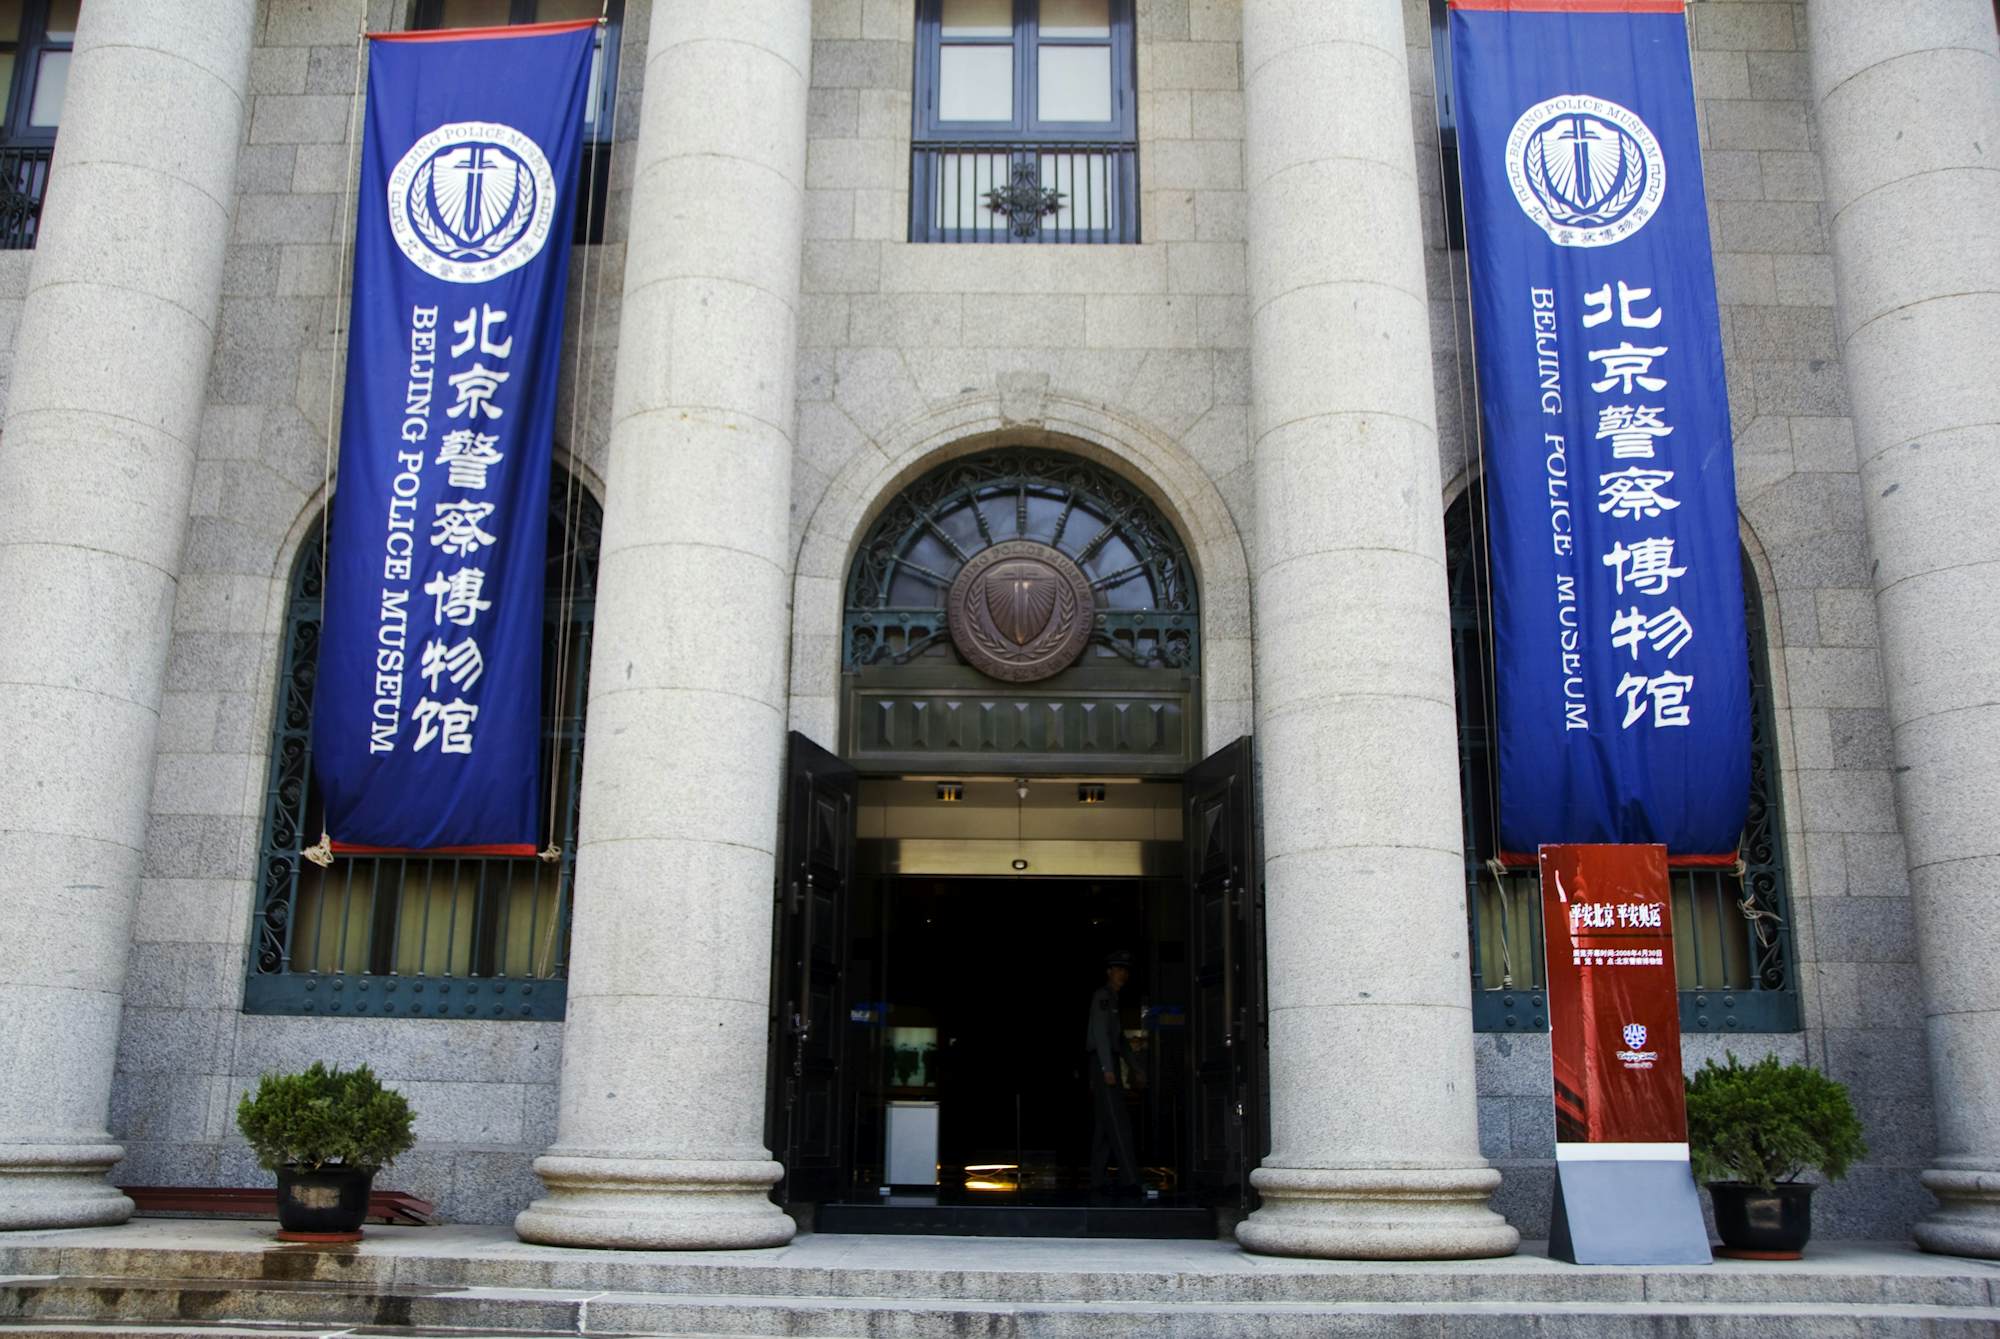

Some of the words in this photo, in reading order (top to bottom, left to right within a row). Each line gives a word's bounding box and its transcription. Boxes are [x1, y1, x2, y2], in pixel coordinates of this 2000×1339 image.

[444, 126, 506, 140] POLICE
[1510, 109, 1544, 157] BEIJING
[1544, 99, 1603, 114] POLICE
[1606, 105, 1660, 160] MUSEUM
[401, 304, 439, 444] BEIJING
[1530, 285, 1563, 416] BEIJING
[384, 450, 424, 581] POLICE
[411, 302, 513, 755] 北京警察博物馆
[1544, 432, 1573, 556] POLICE
[1582, 279, 1694, 730] 北京警察博物馆
[369, 587, 410, 755] MUSEUM
[1556, 573, 1590, 732] MUSEUM
[1570, 903, 1615, 928] 平安北京
[1616, 903, 1662, 928] 平安奥运
